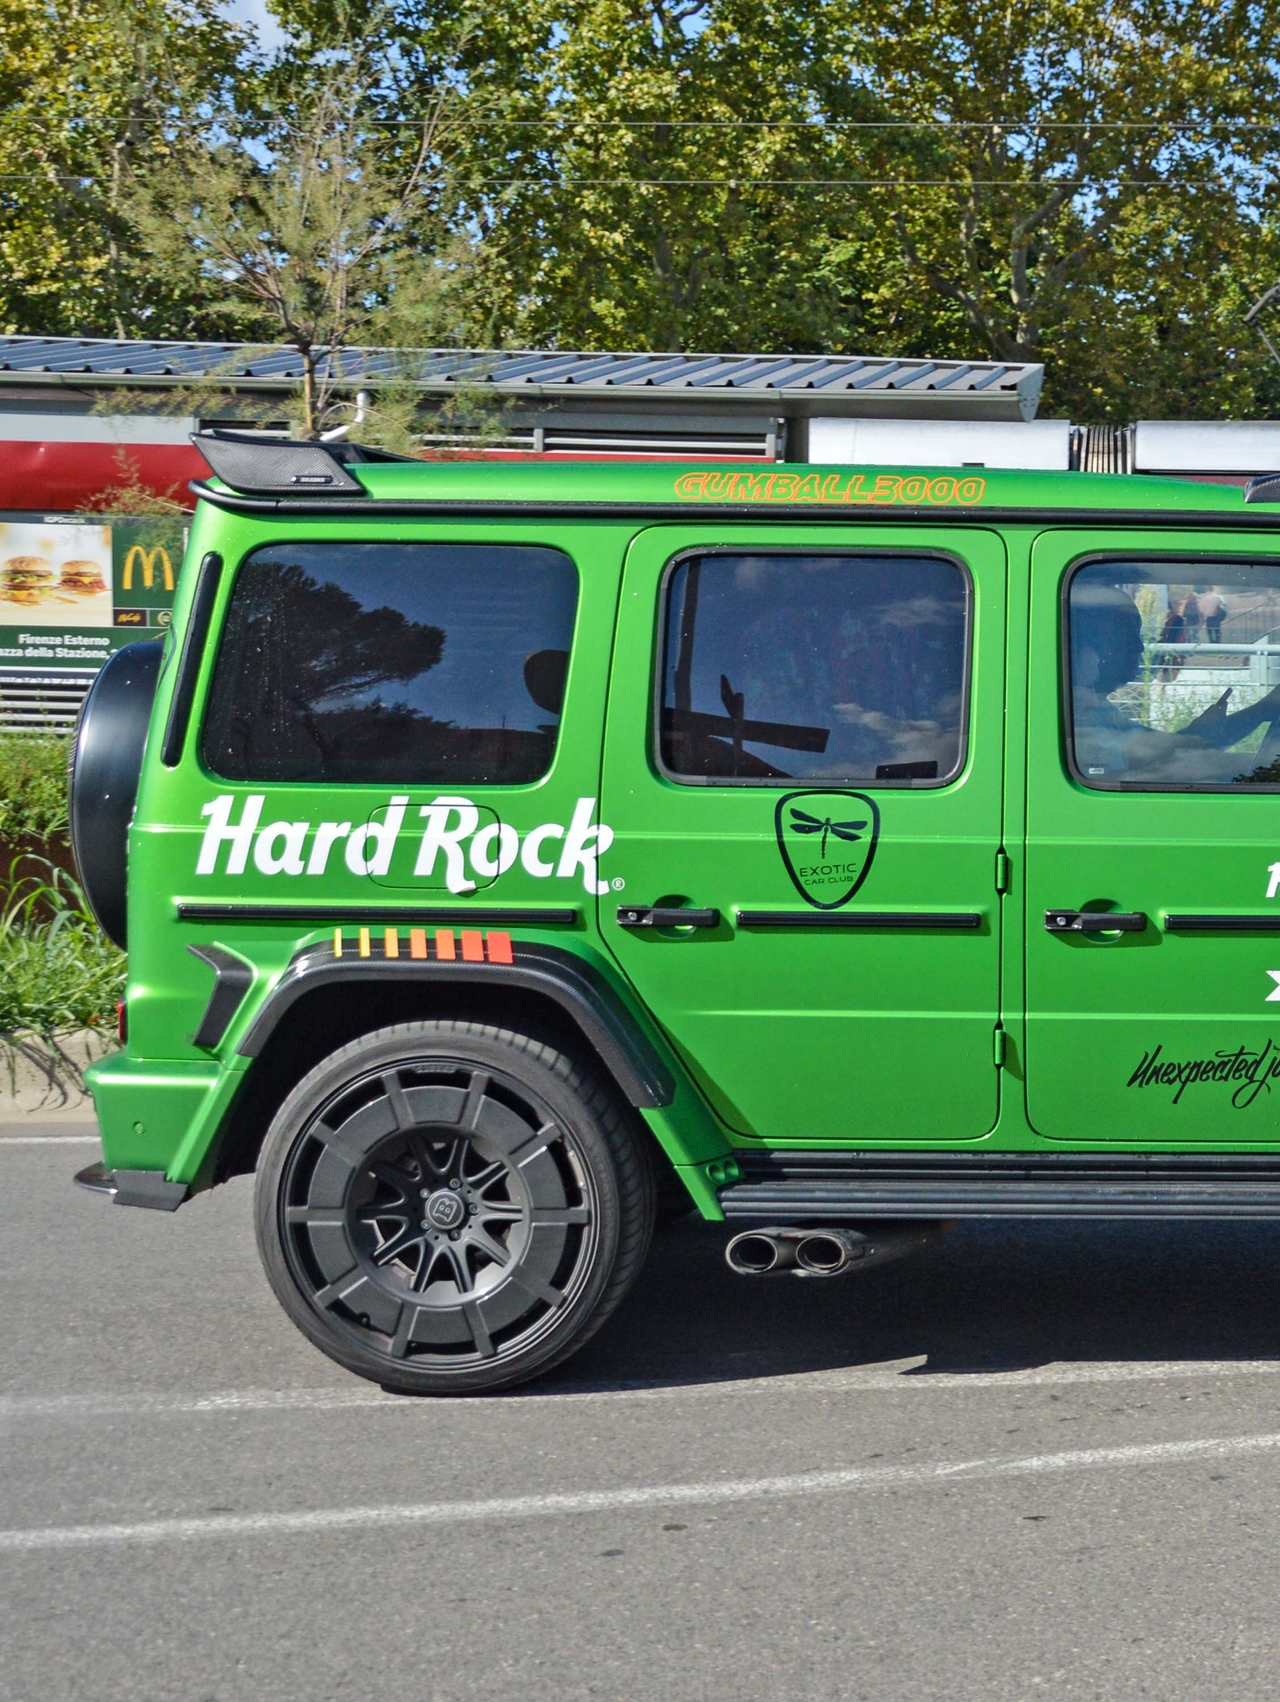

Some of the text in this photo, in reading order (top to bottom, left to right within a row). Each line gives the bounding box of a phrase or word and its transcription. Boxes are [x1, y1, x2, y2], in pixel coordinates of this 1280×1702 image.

[674, 472, 986, 505] GUMBALL3000
[18, 633, 110, 646] Firenze Esterno
[24, 646, 54, 657] della
[196, 795, 409, 876] Hard
[799, 863, 857, 878] EXOTIC
[828, 875, 854, 884] CLUB
[1126, 1038, 1272, 1105] Unexpected
